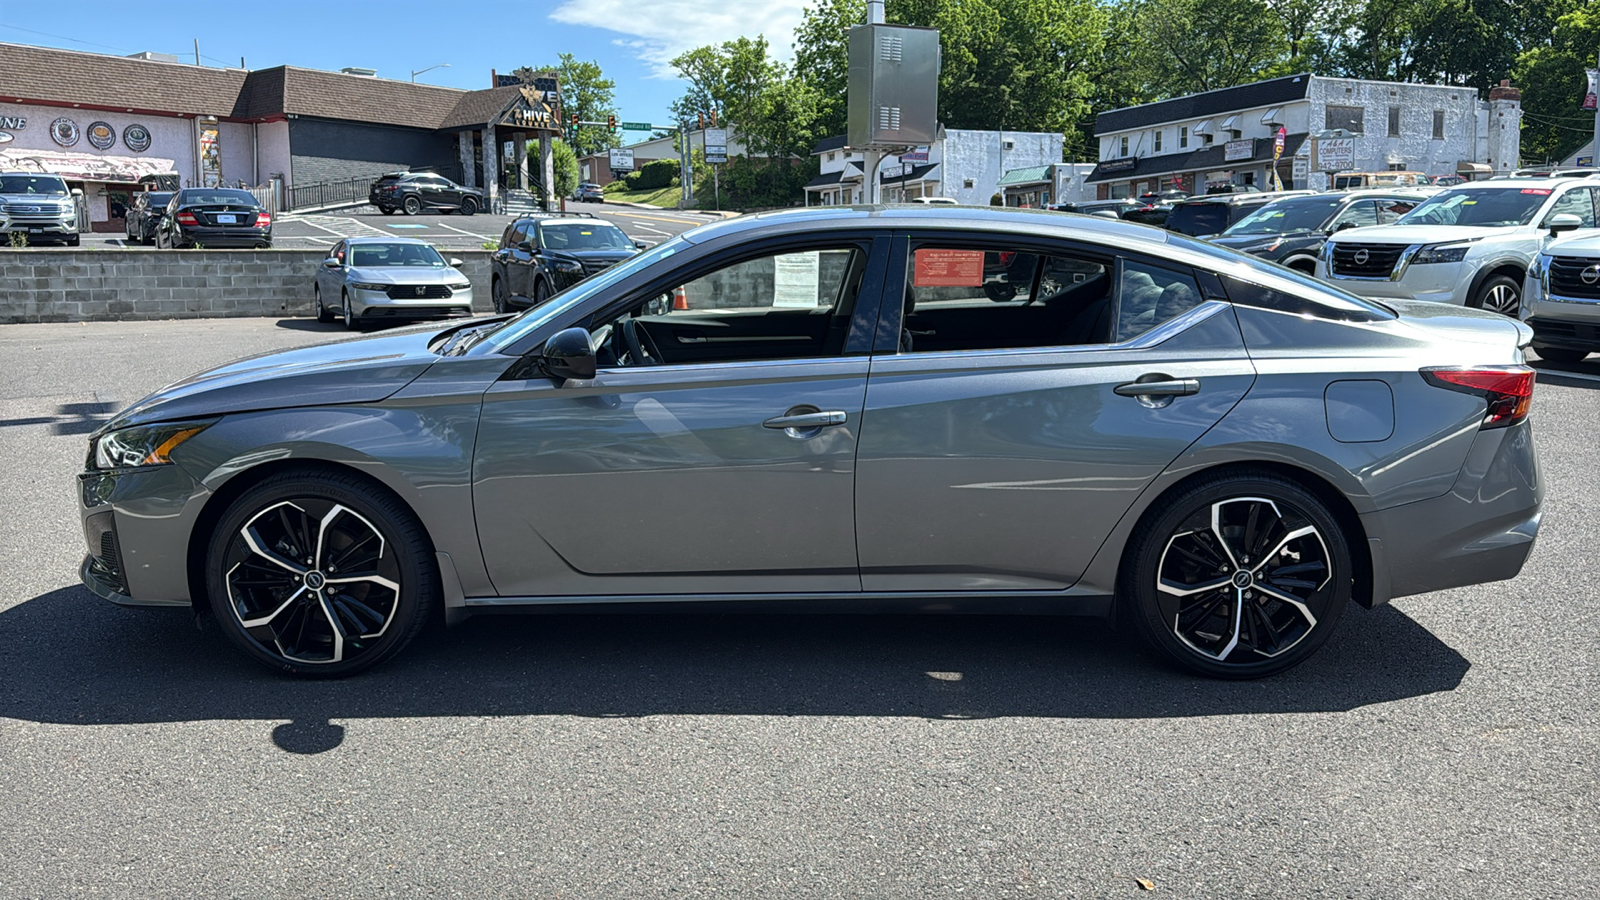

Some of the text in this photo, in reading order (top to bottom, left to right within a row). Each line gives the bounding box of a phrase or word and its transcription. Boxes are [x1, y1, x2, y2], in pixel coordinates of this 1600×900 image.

[523, 109, 550, 123] HIVE
[515, 119, 550, 128] LOUNGE
[1319, 147, 1352, 155] COMPUTERS
[1318, 161, 1353, 170] 942-9700
